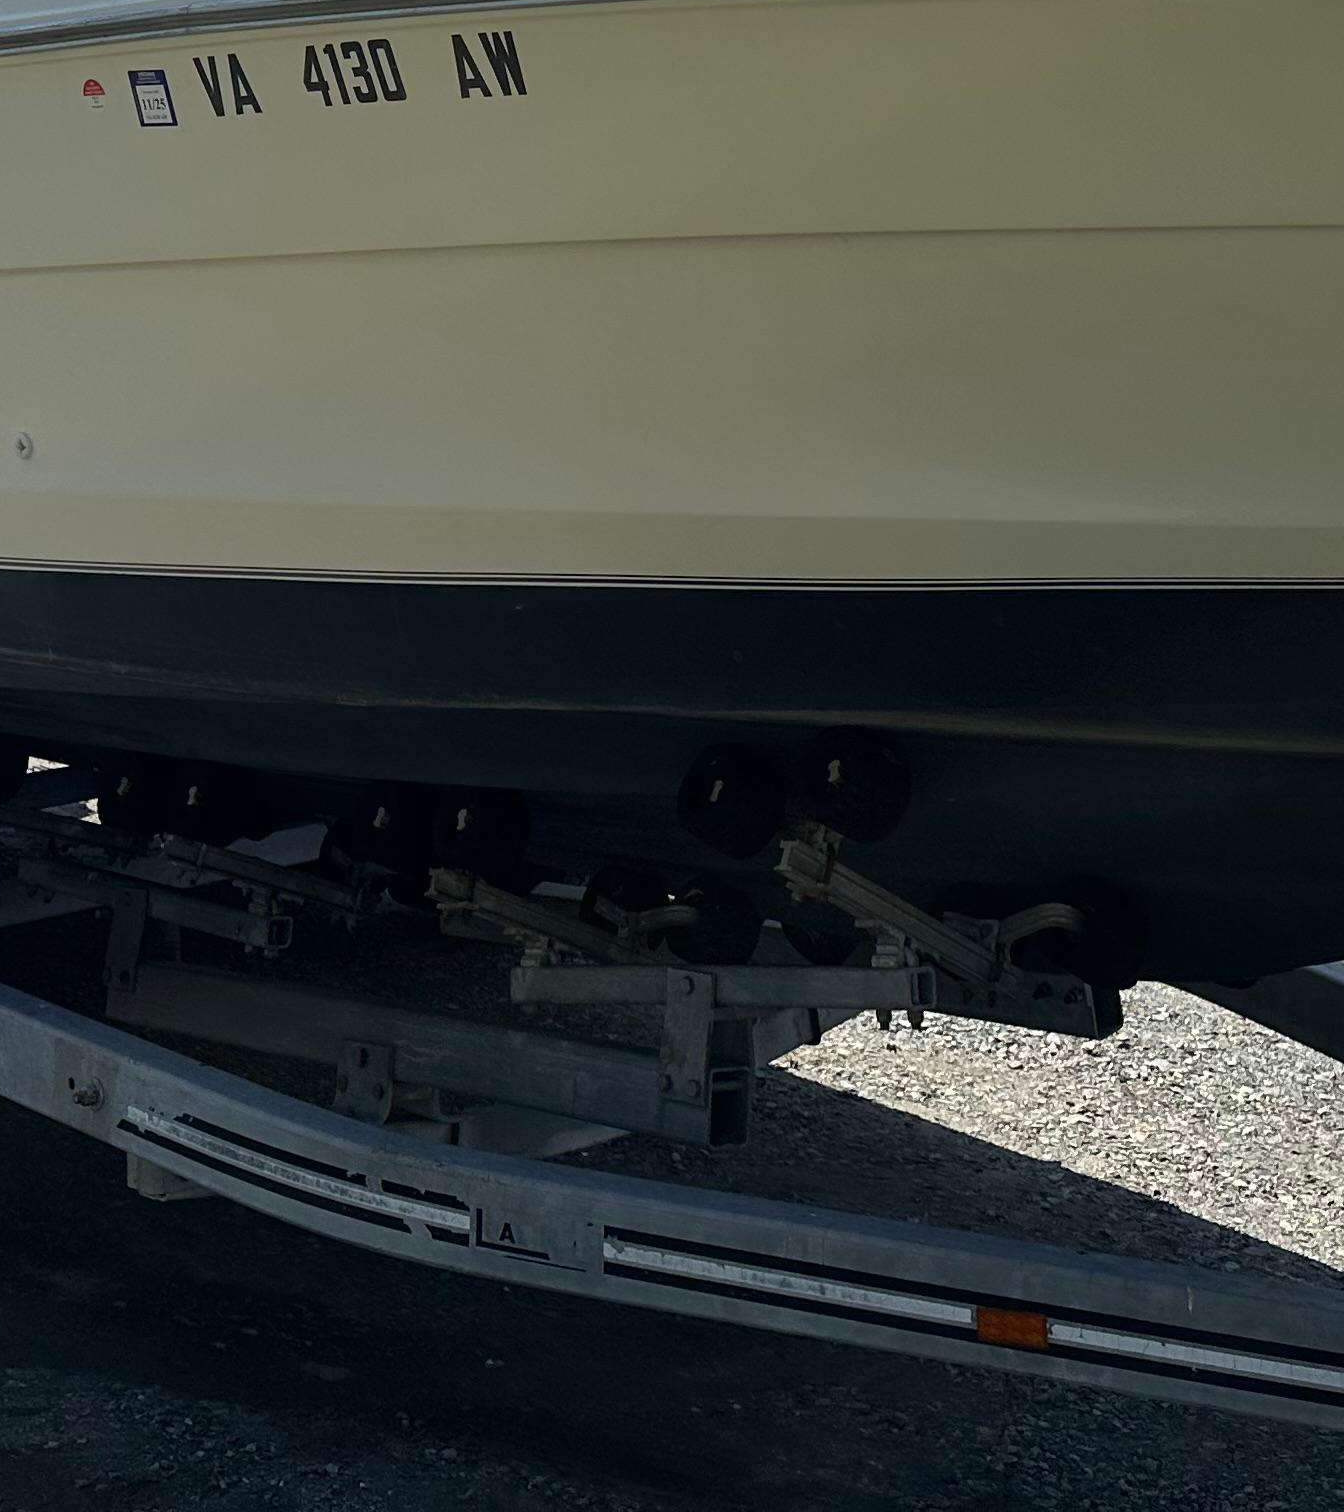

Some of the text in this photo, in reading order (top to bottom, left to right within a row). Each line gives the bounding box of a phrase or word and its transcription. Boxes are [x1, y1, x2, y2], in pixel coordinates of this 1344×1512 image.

[192, 31, 528, 117] VA 4130 AW
[142, 97, 167, 111] 11/25
